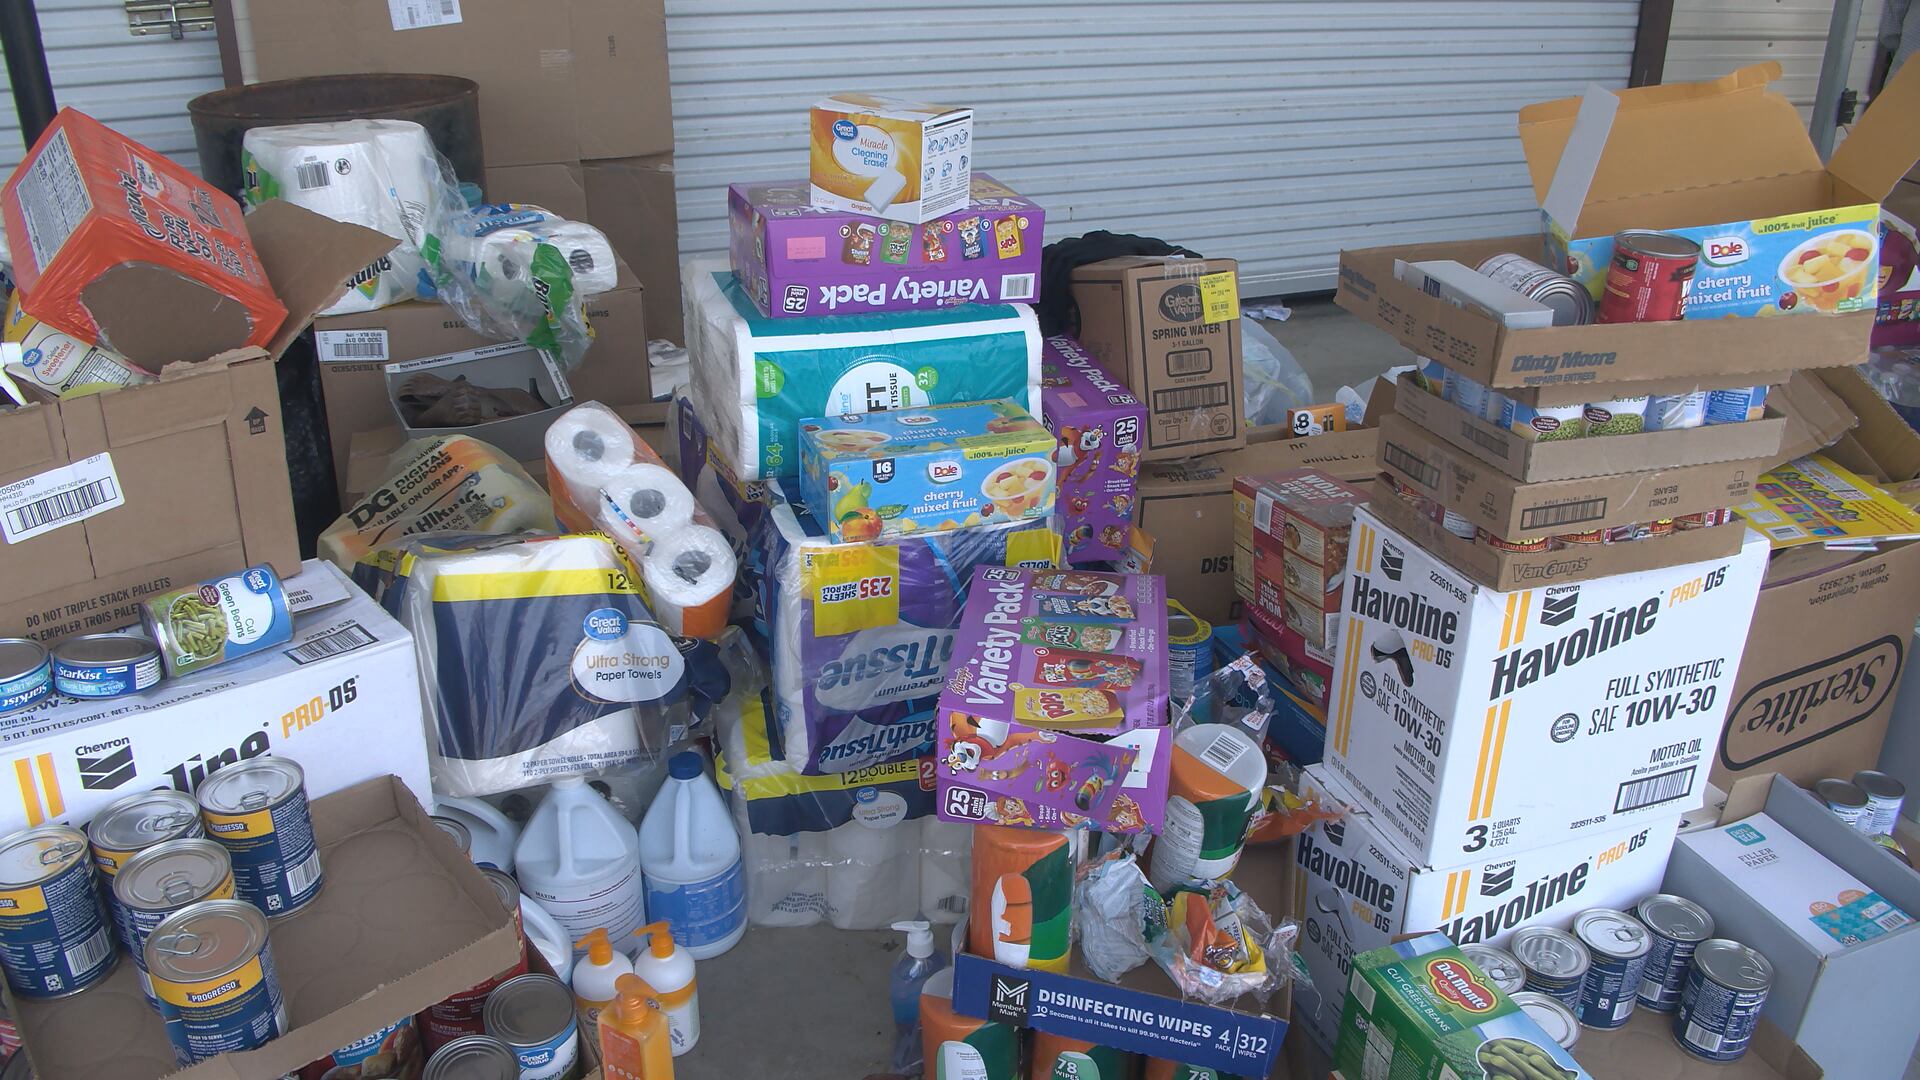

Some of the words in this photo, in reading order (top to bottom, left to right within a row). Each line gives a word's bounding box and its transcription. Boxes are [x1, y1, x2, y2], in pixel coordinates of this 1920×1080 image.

[851, 147, 888, 161] Cleaning
[860, 138, 888, 150] Miracle
[863, 157, 888, 168] Eraser
[851, 203, 872, 212] Original
[1764, 222, 1790, 232] 100%
[1806, 215, 1836, 230] juice
[1710, 242, 1743, 258] Dole
[892, 277, 990, 306] Variety
[1697, 274, 1751, 290] cherry
[1736, 284, 1772, 299] fruit
[784, 297, 807, 310] 25
[820, 283, 887, 309] Pack
[1152, 326, 1187, 341] SPRING
[1189, 323, 1221, 336] WATER
[1182, 338, 1204, 347] GALLON
[1048, 335, 1091, 374] Variety
[1085, 367, 1120, 393] Pack
[1511, 353, 1558, 374] Dinty
[1560, 351, 1617, 367] Moore
[889, 371, 898, 404] TISSUE
[917, 370, 929, 386] 32
[1116, 419, 1137, 435] 25
[974, 450, 992, 461] 100%
[1004, 446, 1027, 458] juice
[395, 450, 449, 489] DIGITAL
[400, 455, 452, 496] COUPONS
[876, 462, 892, 475] 16
[934, 463, 958, 477] Dole
[409, 495, 422, 506] ON
[422, 479, 442, 495] OUR
[442, 464, 464, 481] APP.
[1299, 474, 1355, 499] WOLF
[1653, 485, 1678, 495] BEANS
[913, 501, 951, 515] mixed
[952, 497, 978, 511] fruit
[924, 490, 964, 505] cherry
[348, 489, 398, 529] DG
[1384, 538, 1405, 558] Chevron
[608, 573, 627, 590] 12
[988, 568, 1004, 581] 25
[1860, 573, 1890, 588] Sterilite
[822, 584, 841, 594] ROLL
[822, 589, 857, 603] SHEETS
[842, 582, 857, 591] PER
[860, 576, 892, 598] 235
[1430, 570, 1467, 604] 223511-535
[1546, 585, 1580, 596] Chevron
[1668, 566, 1726, 609] PRO-DS
[1809, 585, 1858, 606] Corporation
[26, 614, 41, 629] DO
[42, 608, 61, 624] NOT
[64, 598, 98, 617] TRIPLE
[99, 589, 130, 608] STACK
[132, 576, 171, 600] PALLETS
[219, 582, 233, 608] Green
[231, 608, 245, 639] Beans
[984, 582, 1025, 626] Pack
[1351, 574, 1458, 645] Havoline
[41, 620, 81, 641] EMPILER
[83, 611, 112, 627] TROIS
[245, 617, 258, 636] Cut
[589, 616, 621, 628] Great
[597, 625, 621, 634] Value
[1413, 639, 1451, 669] PRO-DS
[1489, 596, 1661, 702] Havoline
[586, 654, 618, 669] Ultra
[622, 653, 670, 669] Strong
[966, 625, 1022, 705] Variety
[58, 666, 102, 680] StarKist
[595, 670, 625, 682] Paper
[627, 668, 662, 680] Towels
[1606, 674, 1640, 701] FULL
[1645, 658, 1725, 693] SYNTHETIC
[3, 683, 48, 707] StarKist
[1383, 672, 1401, 699] FULL
[1402, 686, 1446, 736] SYNTHETIC
[1747, 654, 1886, 736] Sterilite
[281, 677, 357, 740] PRO-DS
[1041, 691, 1077, 720] POPS
[1588, 704, 1619, 736] SAE
[1625, 685, 1717, 729] 10W-30
[13, 731, 29, 741] QT.
[31, 713, 109, 736] BOTTLES/CONT.
[111, 707, 133, 717] NET.
[1376, 688, 1391, 715] SAE
[1393, 703, 1441, 758] 10W-30
[75, 737, 130, 757] Chevron
[587, 753, 602, 761] TOTAL
[604, 751, 618, 760] AREA
[1650, 741, 1686, 764] MOTOR
[1687, 738, 1702, 754] OIL
[1403, 740, 1426, 768] MOTOR
[1426, 761, 1436, 778] OIL
[840, 769, 859, 786] 12
[859, 761, 907, 780] DOUBLE
[950, 790, 970, 816] 25
[971, 797, 979, 815] mini
[978, 799, 987, 817] boxes
[1498, 816, 1521, 829] QUARTS
[1570, 815, 1607, 830] 223511-535
[1463, 824, 1488, 853] 3
[1597, 829, 1648, 870] PRO-DS
[1738, 847, 1773, 862] FILLER
[1368, 844, 1404, 880] 223511-535
[1484, 859, 1516, 872] Chevron
[1745, 853, 1779, 868] PAPER
[1298, 832, 1395, 913] Havoline
[1436, 865, 1589, 949] Havoline
[1352, 902, 1390, 934] PRO-DS
[191, 981, 237, 1003] PROGRESSO
[1436, 962, 1455, 980] Del
[1452, 972, 1489, 1010] Monte
[992, 1001, 1027, 1015] Member's
[1387, 966, 1404, 988] CUT
[1401, 982, 1427, 1012] GREEN
[1424, 1004, 1451, 1033] BEANS
[999, 1008, 1018, 1018] Mark
[1036, 1005, 1048, 1014] 10
[1049, 1009, 1077, 1021] Seconds
[1100, 1019, 1118, 1029] takes
[1127, 1026, 1138, 1034] kill
[1139, 1029, 1160, 1040] 99.9%
[1038, 988, 1155, 1026] DISINFECTING
[1158, 1014, 1213, 1039] WIPES
[1219, 1028, 1230, 1045] 4
[1238, 1033, 1268, 1054] 312
[520, 1050, 549, 1063] Great
[1215, 1044, 1231, 1052] PACK
[1238, 1049, 1257, 1059] WIPES
[526, 1058, 551, 1067] Value
[1056, 1057, 1078, 1075] 78
